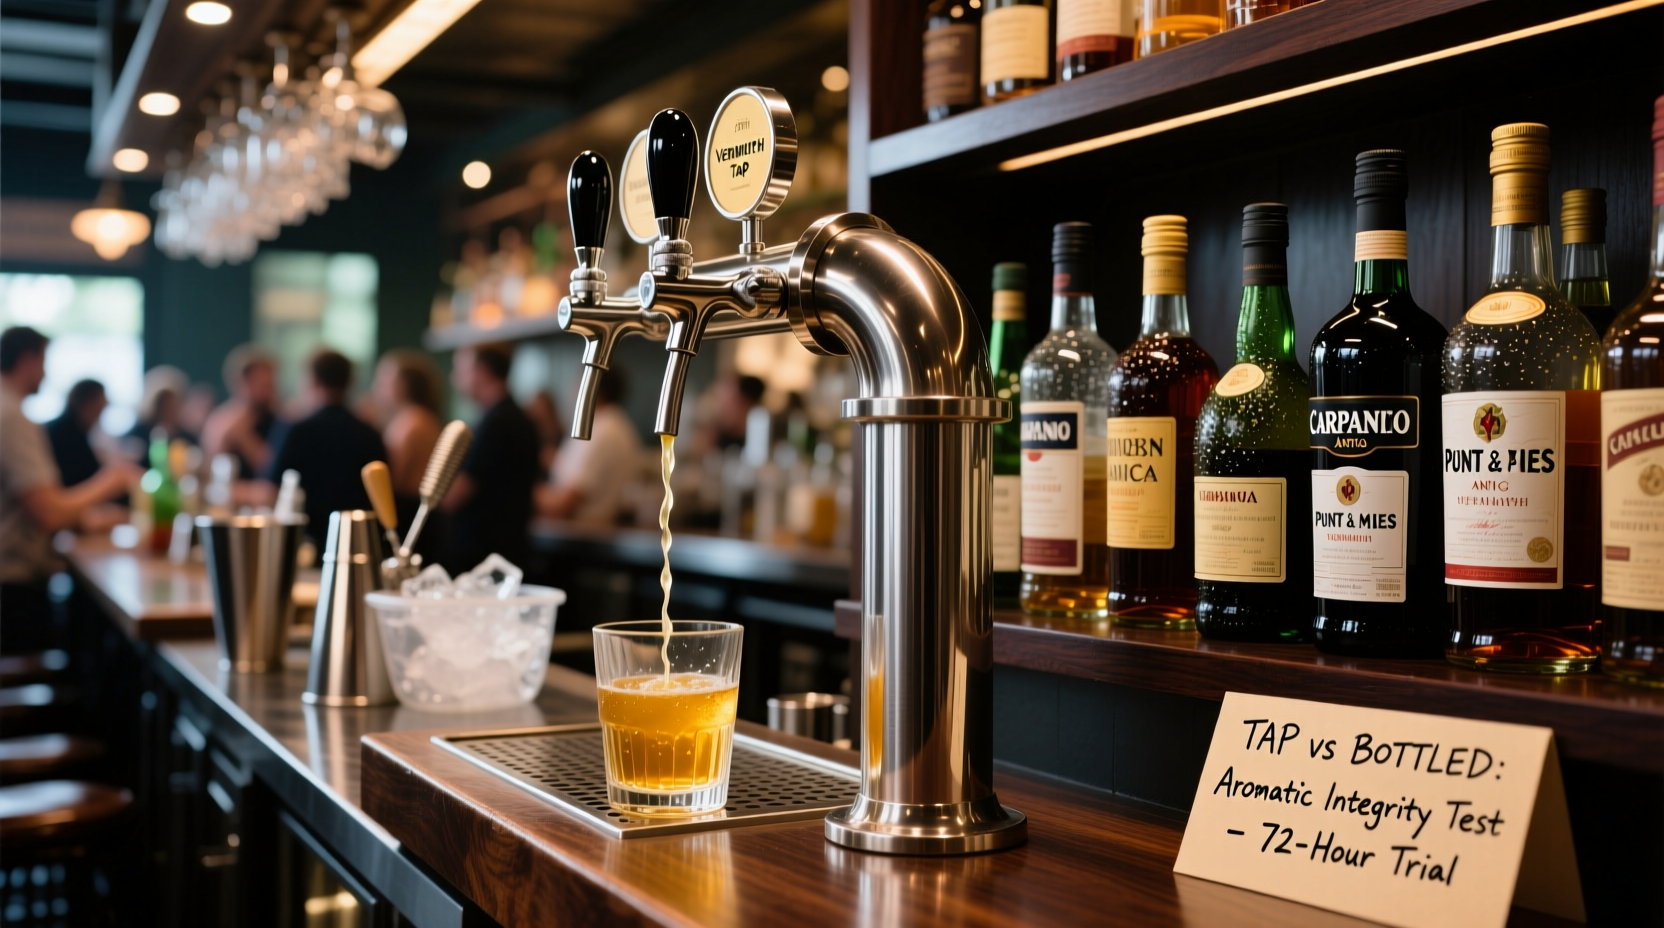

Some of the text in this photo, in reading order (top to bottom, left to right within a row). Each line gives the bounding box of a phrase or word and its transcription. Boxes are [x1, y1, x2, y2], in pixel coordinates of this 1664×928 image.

[730, 161, 750, 179] TAP
[1445, 448, 1484, 473] PUNT
[1488, 450, 1502, 473] &
[1315, 511, 1397, 529] PUNT & MIES
[1243, 719, 1505, 780] TAP vs BOTTLED:
[1213, 766, 1505, 840] Aromatic Integrity Test
[1260, 822, 1376, 868] 72-Hour
[1391, 846, 1459, 886] Trial
